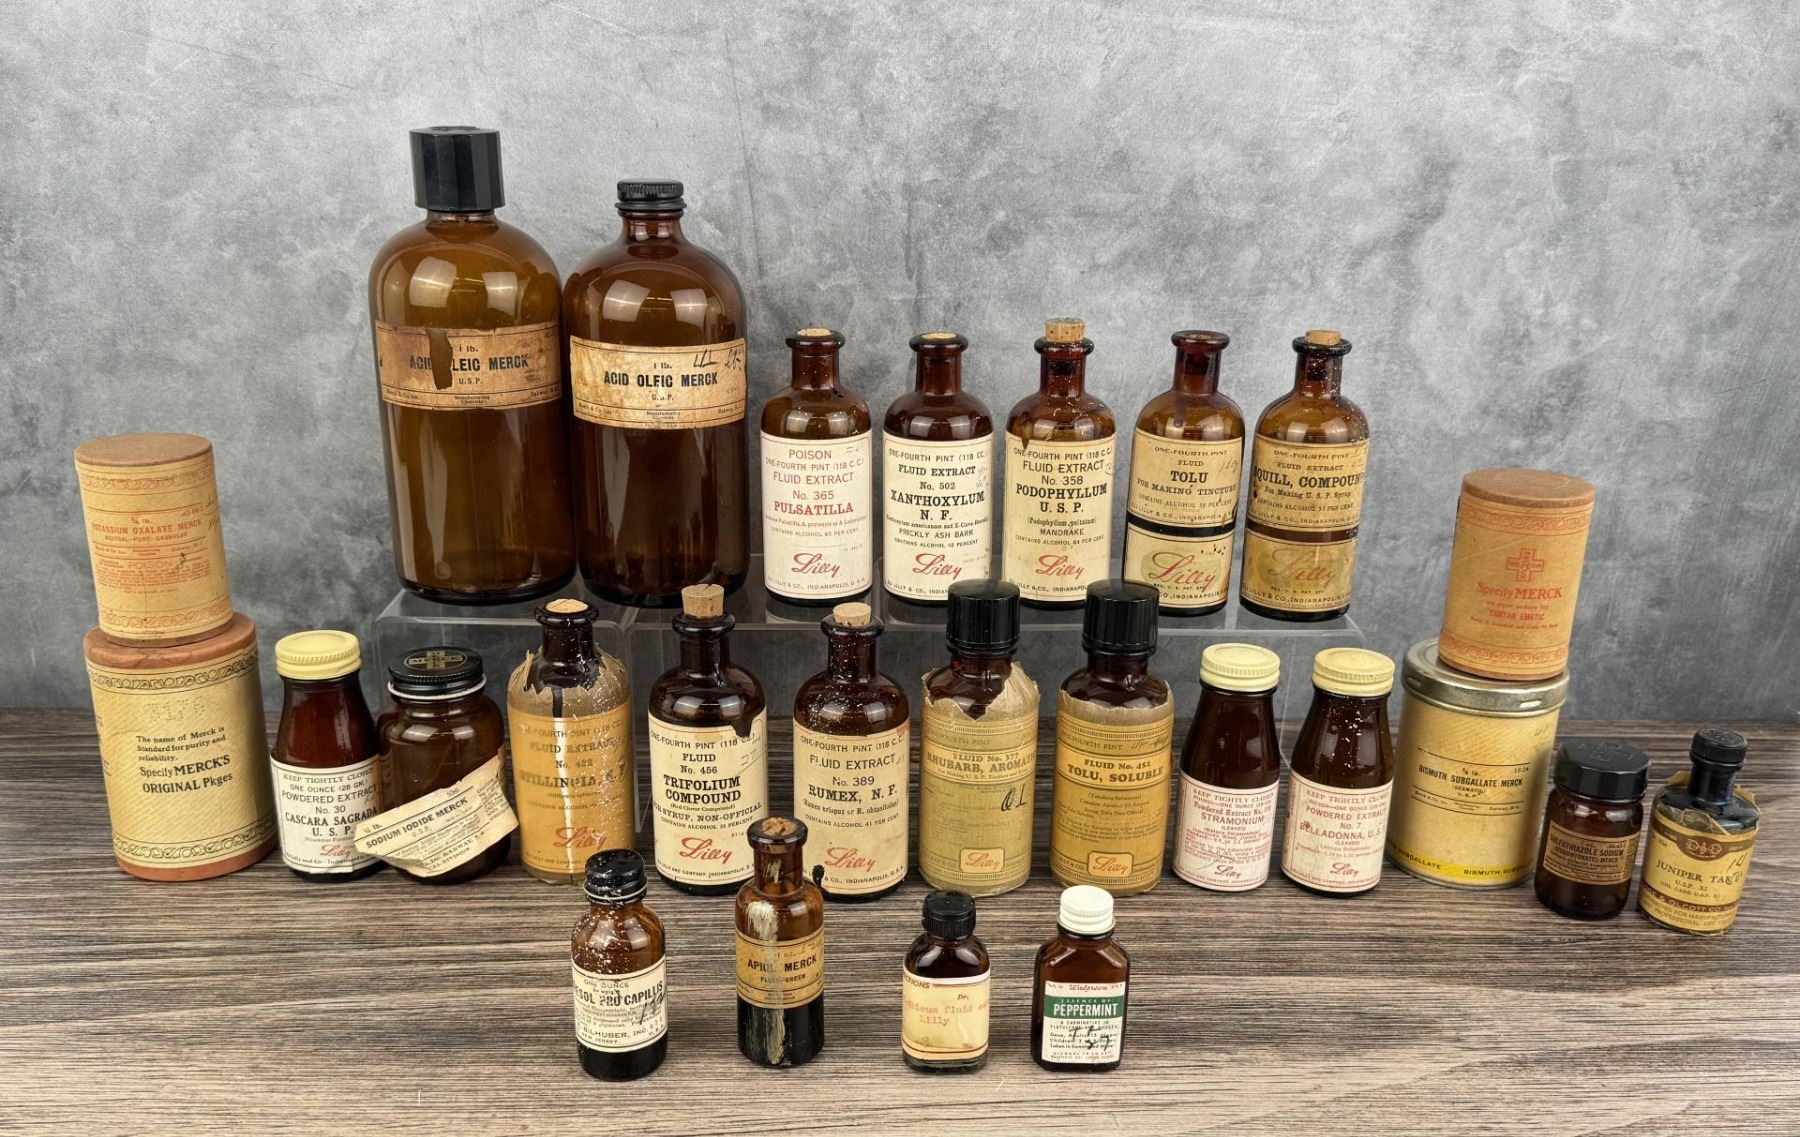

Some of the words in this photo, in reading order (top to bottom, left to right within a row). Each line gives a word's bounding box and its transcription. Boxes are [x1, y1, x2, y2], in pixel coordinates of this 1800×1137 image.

[452, 358, 480, 371] LEIC
[489, 355, 528, 370] MERCK
[604, 371, 629, 385] ACID
[681, 372, 718, 386] MERCK
[789, 449, 831, 459] POISON
[889, 449, 931, 462] ONE-FOURTH
[1013, 448, 1060, 460] ONE-FOURTH
[1155, 447, 1209, 456] ONE-FOURTH
[766, 457, 806, 471] ONE-FOURTH
[812, 463, 829, 471] PINT
[898, 464, 926, 476] FLUID
[931, 466, 976, 476] EXTRACT
[1023, 460, 1053, 473] FLUID
[1058, 460, 1104, 473] EXTRACT
[1277, 462, 1300, 470] FLUID
[773, 472, 801, 484] FLUID
[806, 472, 854, 485] EXTRACT
[1063, 476, 1083, 484] 358
[1171, 471, 1208, 483] TOLU
[920, 482, 934, 490] No.
[939, 482, 955, 490] 502
[1016, 483, 1107, 499] PODOPHYLLUM
[1137, 478, 1149, 488] FOR
[1152, 483, 1193, 495] MAKING
[793, 490, 808, 500] No.
[814, 491, 834, 500] 365
[890, 489, 984, 507] XANTHOXYLUM
[1278, 489, 1303, 499] Making
[774, 501, 853, 515] PULSATILLA
[133, 525, 172, 534] OXALATE
[178, 519, 201, 530] MERCK
[899, 528, 929, 538] PRICKLY
[935, 530, 951, 538] ASH
[955, 529, 974, 538] BARK
[128, 560, 173, 569] POISON
[792, 553, 841, 578] Lilly
[912, 553, 962, 580] Lilly
[1035, 555, 1084, 580] Lilly
[1148, 552, 1216, 592] Lilly
[1268, 548, 1336, 588] Lilly
[1515, 587, 1562, 600] MERCK
[136, 735, 151, 743] The
[178, 734, 187, 742] of
[190, 729, 216, 740] Merck
[137, 744, 170, 752] Standard
[185, 740, 209, 751] purity
[212, 735, 226, 743] and
[651, 731, 690, 749] ONE-FOURTH
[721, 738, 737, 748] (118
[801, 735, 847, 752] ONE-FOURTH
[529, 741, 561, 753] FLUID
[139, 754, 178, 762] reliability.
[555, 761, 571, 769] No.
[683, 754, 716, 762] FLUID
[810, 755, 840, 769] FLUID
[846, 754, 895, 770] EXTRACT
[927, 752, 983, 774] RHUBARB,
[990, 751, 1036, 773] AROMATI
[1084, 759, 1114, 769] FLUID
[140, 766, 173, 778] Specify
[174, 755, 230, 776] MERCK'S
[681, 765, 695, 774] No.
[700, 766, 717, 774] 456
[1068, 764, 1103, 783] TOLU,
[1109, 767, 1163, 783] SOLUBLE
[143, 780, 200, 794] ORIGINAL
[203, 773, 233, 789] Pkges
[664, 774, 741, 791] TRIFOLIUM
[853, 776, 874, 786] 389
[1419, 765, 1447, 780] BISMUTH
[1451, 775, 1497, 788] SUBGALLATE
[1501, 778, 1523, 788] MERCK
[282, 790, 333, 804] POWDERED
[338, 784, 377, 802] EXTRACT
[666, 789, 741, 804] COMPOUND
[809, 784, 861, 804] RUMEX,
[1307, 790, 1325, 799] KEEP
[316, 806, 330, 814] No.
[334, 805, 345, 813] 30
[663, 809, 693, 822] SYRUP,
[697, 802, 762, 822] NON-OFFICIAL
[1194, 801, 1223, 814] Powdered
[1306, 806, 1352, 820] POWDERED
[1357, 808, 1387, 820] EXTRACT
[285, 812, 328, 826] CASCARA
[334, 806, 377, 825] SAGRADA
[366, 827, 401, 848] SODIUM
[402, 812, 434, 834] IODIDE
[436, 796, 468, 819] MERCK
[1201, 813, 1264, 825] STRAMONIUM
[553, 827, 606, 849] Lilly
[320, 844, 352, 857] Lilly
[679, 837, 732, 864] Lilly
[825, 847, 876, 871] Lilly
[1092, 856, 1128, 874] Lilly
[1215, 864, 1242, 879] Lilly
[1330, 862, 1359, 877] Lilly
[1656, 860, 1702, 882] JUNIPER
[748, 960, 777, 972] APIOL
[784, 954, 816, 972] MERCK
[785, 974, 806, 982] GREEN
[624, 981, 663, 1005] CAPILLIS
[1053, 1004, 1118, 1016] PEPPERMINT
